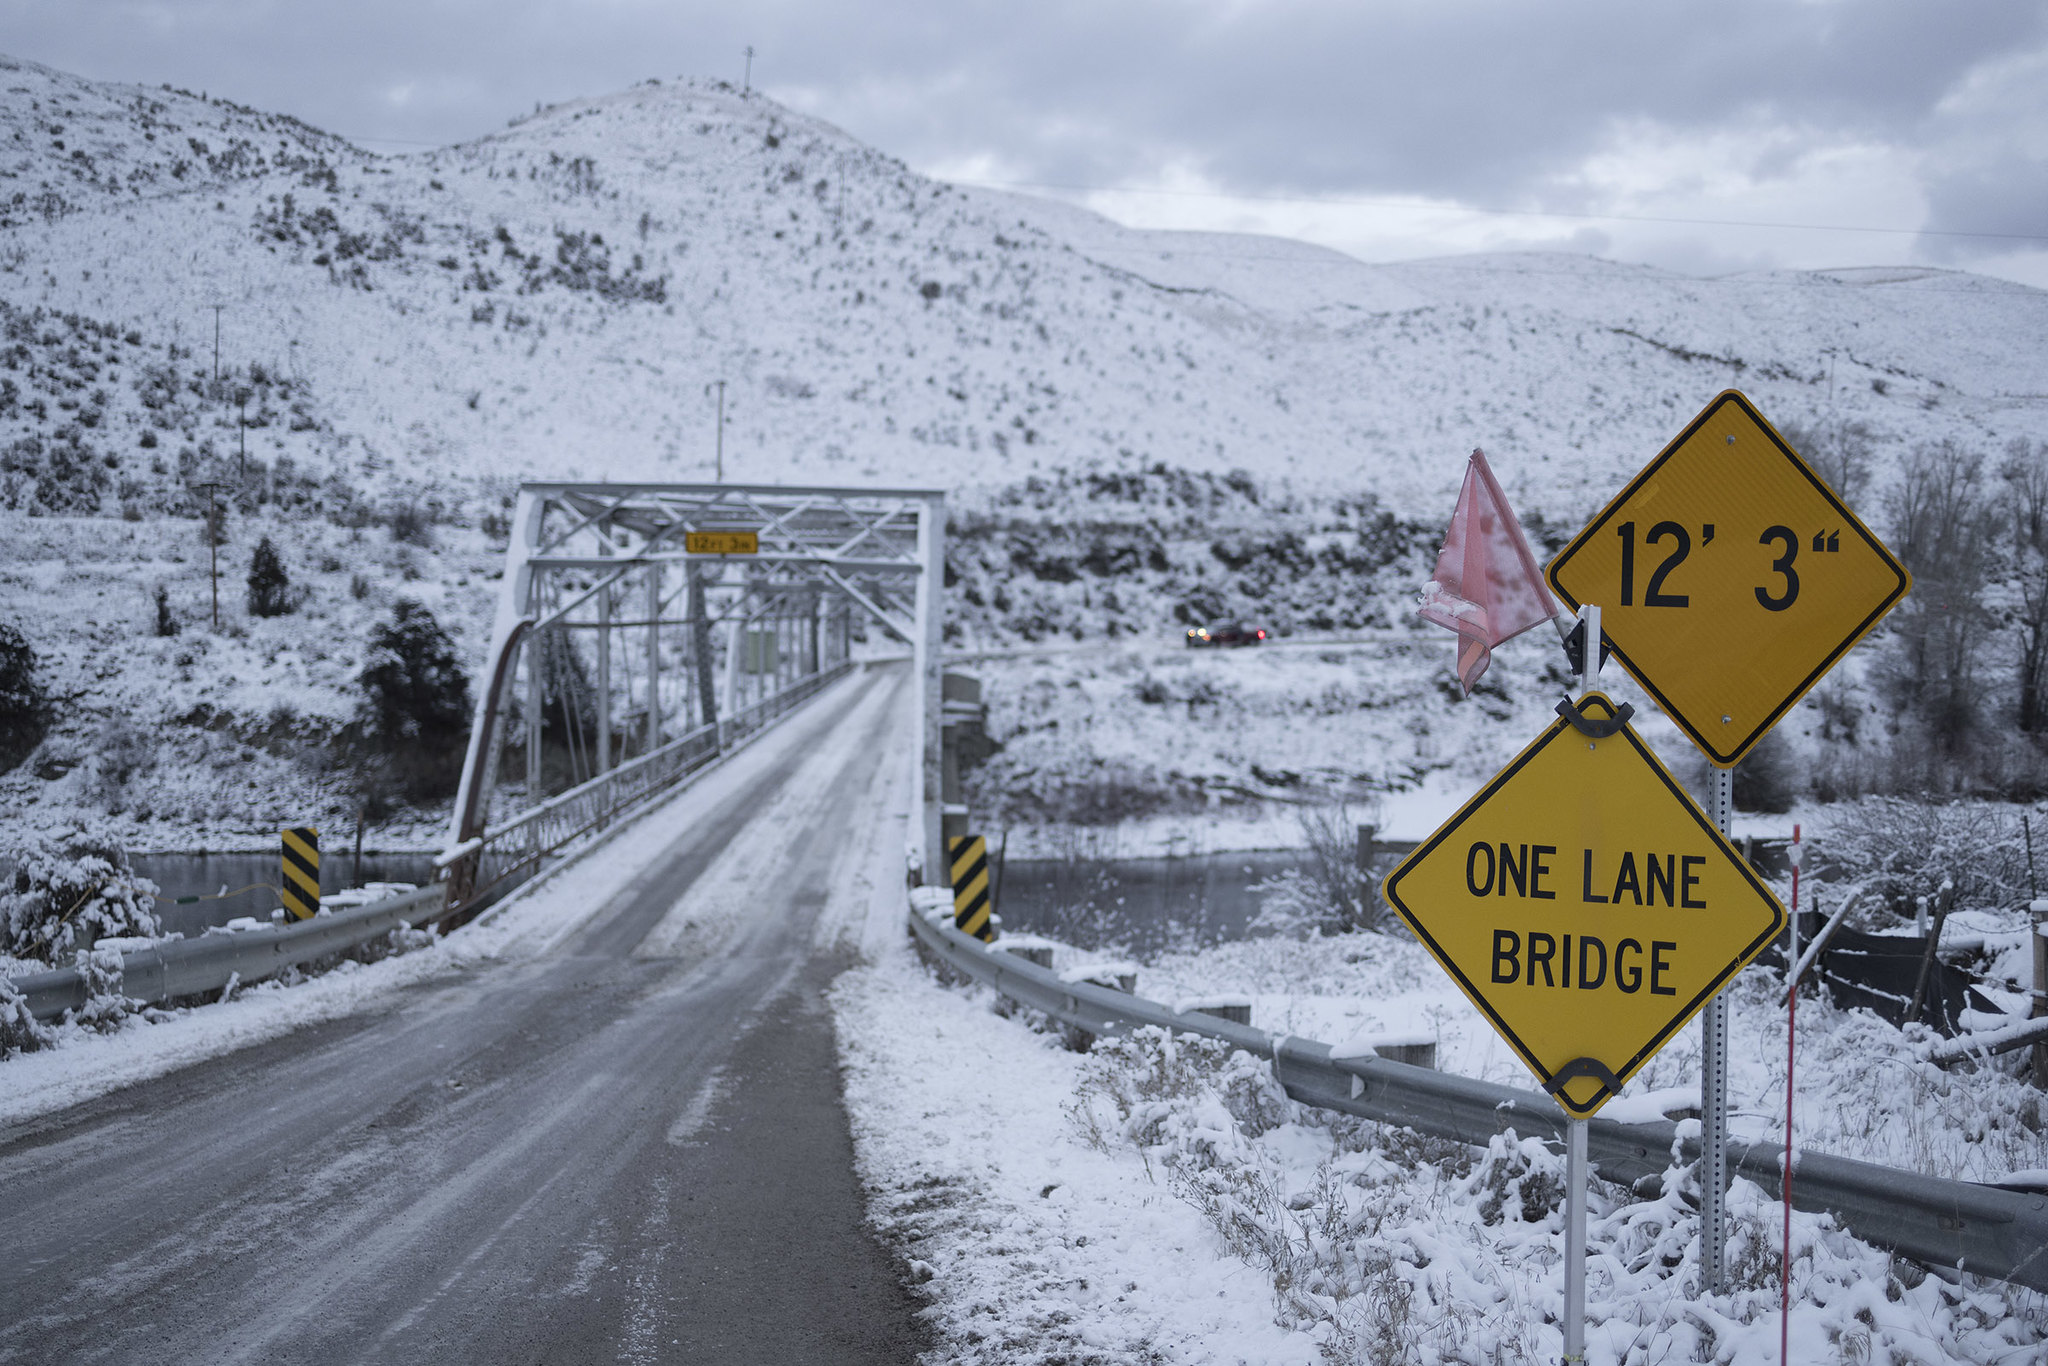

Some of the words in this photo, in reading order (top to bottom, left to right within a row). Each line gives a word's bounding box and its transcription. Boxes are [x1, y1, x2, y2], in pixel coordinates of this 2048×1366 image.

[1466, 841, 1557, 900] ONE
[1582, 848, 1707, 910] LANE
[1491, 928, 1677, 997] BRIDGE
